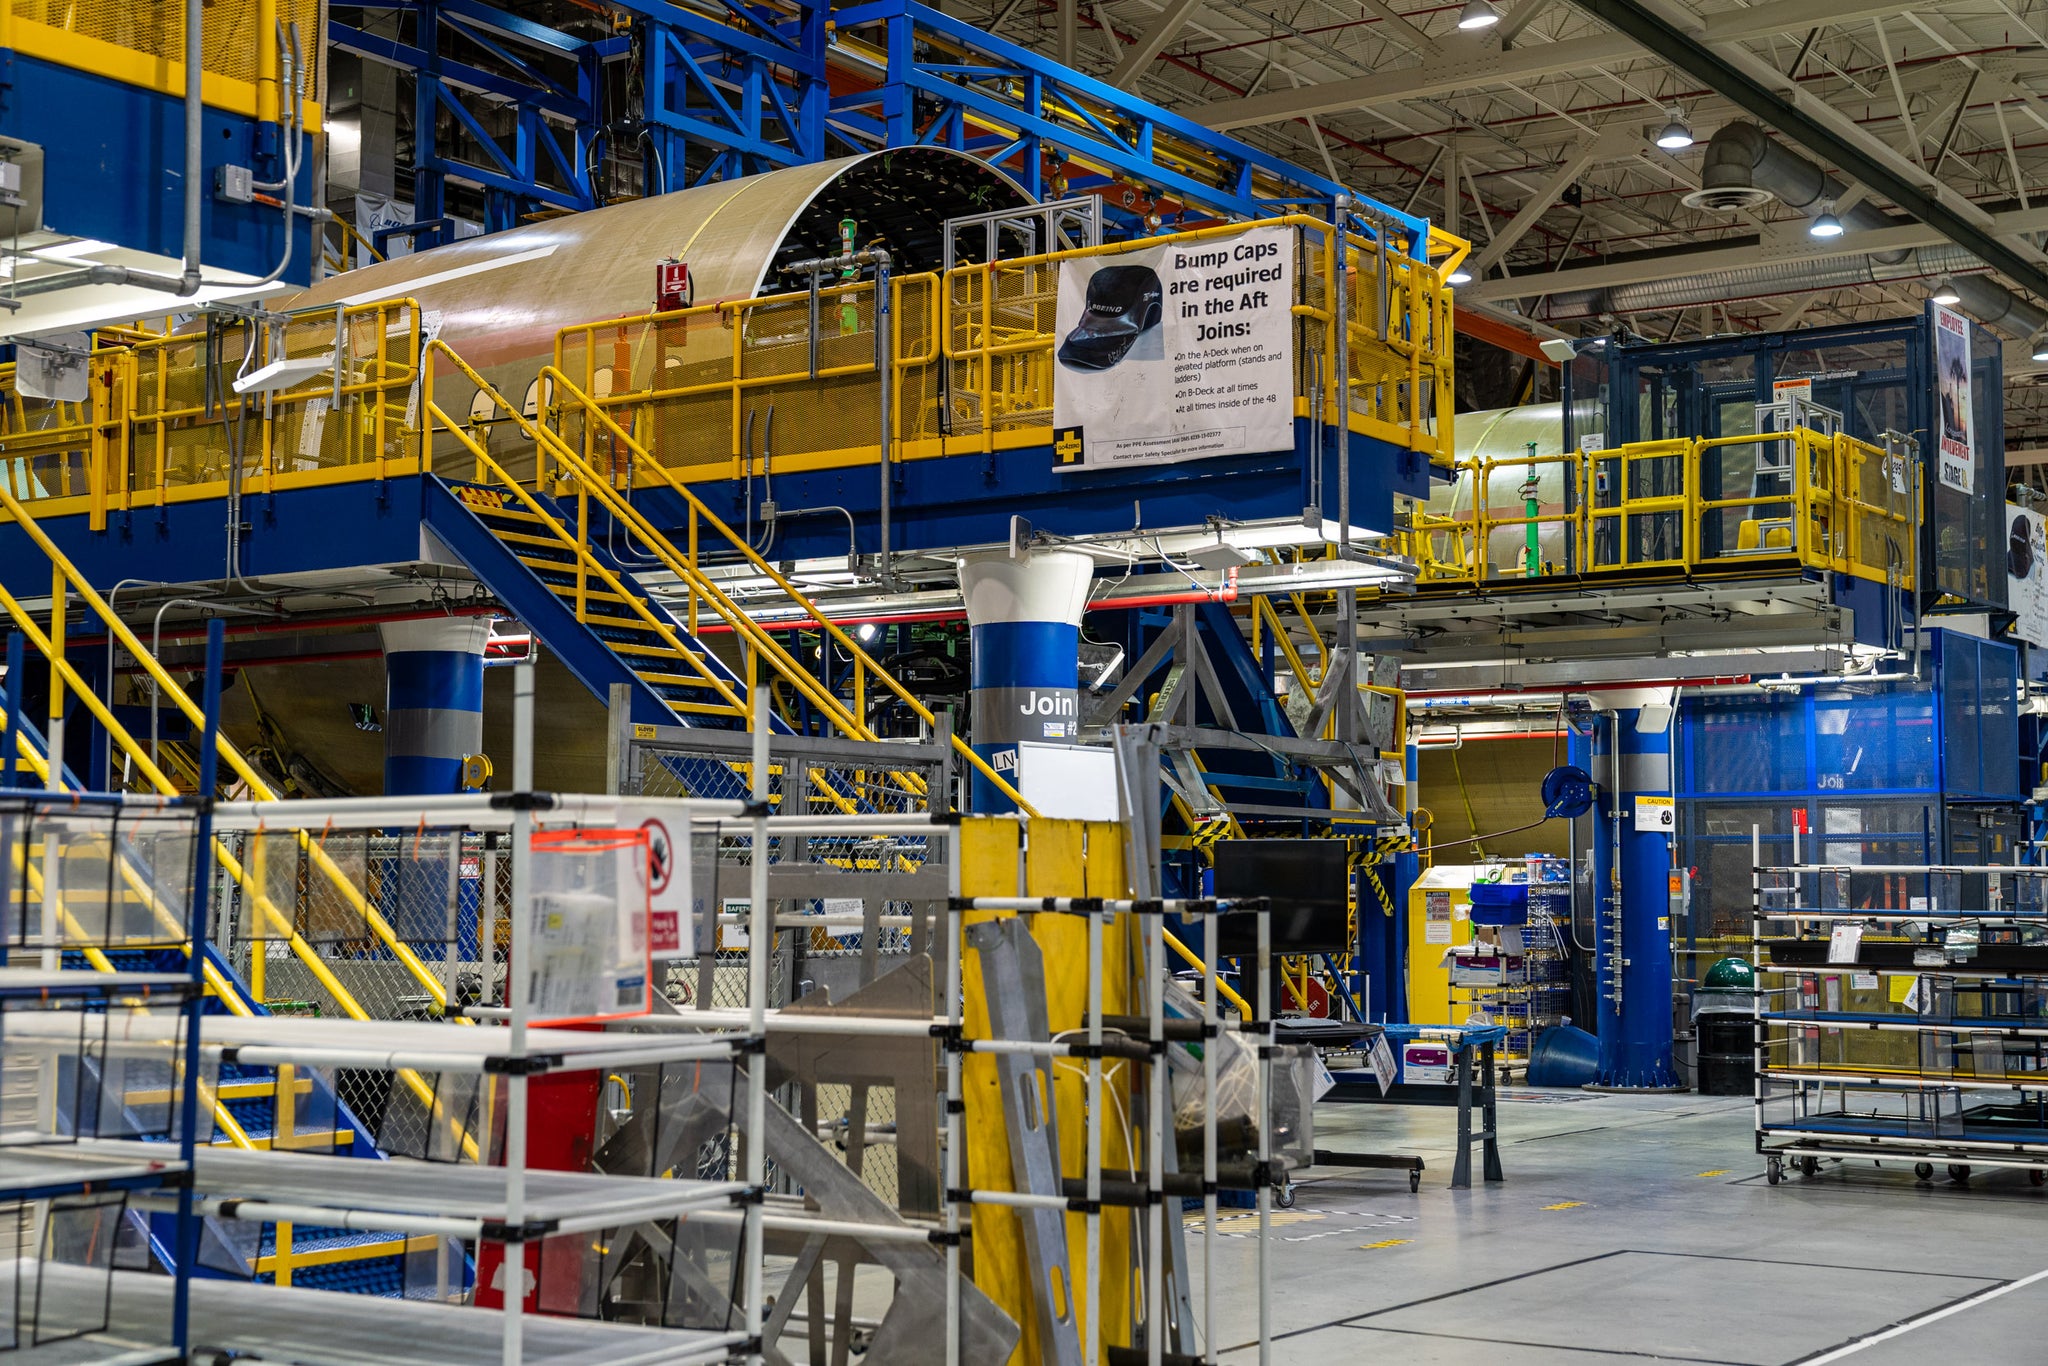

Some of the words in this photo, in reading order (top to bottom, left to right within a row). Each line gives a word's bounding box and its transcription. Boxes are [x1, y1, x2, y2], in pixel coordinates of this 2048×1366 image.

[1174, 251, 1228, 270] Bump
[1234, 243, 1278, 262] Caps
[1169, 280, 1199, 295] are
[1205, 263, 1282, 291] required
[1092, 303, 1122, 313] BOEING
[1181, 301, 1199, 318] in
[1204, 298, 1234, 315] the
[1239, 291, 1268, 310] Aft
[1196, 321, 1251, 341] Joins:
[1940, 311, 1964, 335] EMPLOYEE
[1188, 351, 1201, 359] the
[1203, 347, 1229, 358] A-Deck
[1231, 345, 1251, 355] when
[1253, 344, 1263, 352] on
[1174, 361, 1203, 373] elevated
[1205, 358, 1237, 370] platform
[1238, 354, 1266, 366] (stands
[1267, 351, 1282, 361] and
[1174, 372, 1201, 384] ladders)
[1188, 386, 1215, 397] B-Deck
[1216, 386, 1225, 394] at
[1226, 384, 1236, 393] all
[1237, 382, 1258, 392] times
[1178, 405, 1185, 413] At
[1186, 403, 1194, 412] all
[1195, 401, 1216, 411] times
[1218, 399, 1241, 409] inside
[1242, 396, 1251, 406] of
[1252, 396, 1265, 405] the
[1266, 394, 1277, 403] 48
[1142, 439, 1171, 447] Assessment
[1020, 691, 1073, 716] Join
